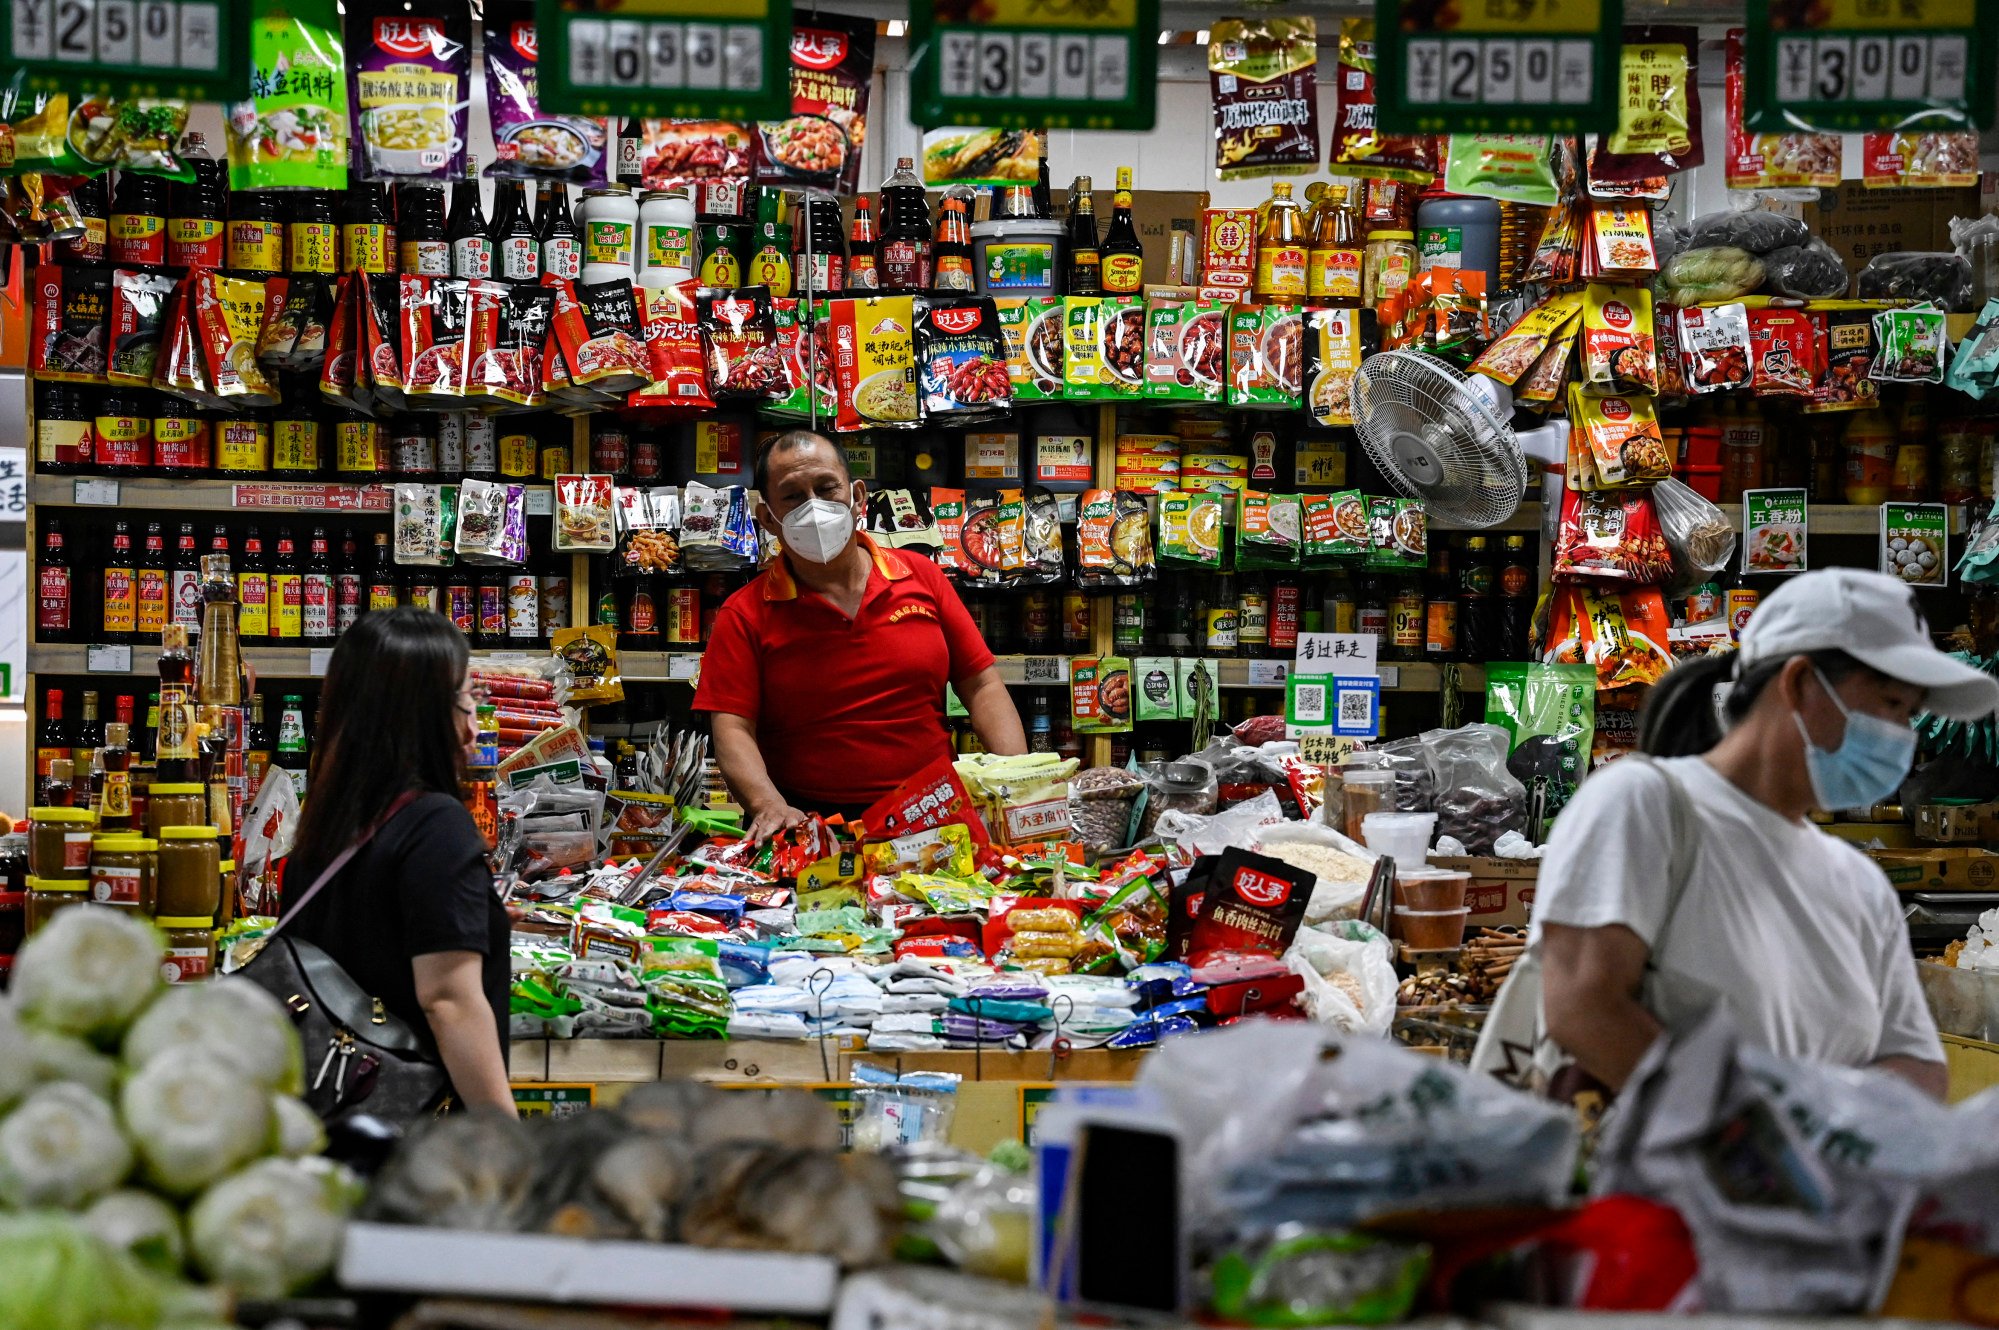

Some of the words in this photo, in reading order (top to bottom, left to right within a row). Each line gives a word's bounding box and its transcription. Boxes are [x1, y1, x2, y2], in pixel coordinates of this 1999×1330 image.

[380, 21, 437, 42] 好人家
[1220, 98, 1309, 130] 万州烤鱼调料
[233, 228, 263, 242] 海天酱油
[1602, 229, 1646, 239] 白胡椒粉
[307, 235, 321, 267] 味极鲜
[885, 249, 914, 260] 海天酱油
[468, 249, 479, 275] 味极鲜
[515, 249, 526, 275] 味极鲜
[557, 249, 569, 275] 味极鲜
[887, 263, 912, 273] 老抽王
[77, 292, 99, 304] 牛油
[591, 300, 632, 313] 小龙虾
[715, 303, 752, 315] 好家
[45, 299, 58, 330] 海底捞
[121, 302, 132, 333] 海底捞
[593, 311, 632, 326] 调味料
[935, 311, 978, 326] 好人家
[1154, 312, 1175, 324] 家樂
[1605, 312, 1630, 322] 红太阳
[1235, 316, 1257, 328] 家樂
[475, 311, 489, 353] 筷手小厨
[1692, 327, 1725, 340] 红烧肉
[837, 325, 853, 367] 欧厨
[864, 339, 913, 354] 酸汤肥牛
[1707, 335, 1741, 346] 调味料
[871, 353, 909, 366] 调味料
[1330, 350, 1351, 359] 肥牛
[226, 429, 256, 443] 海天酱油
[106, 442, 139, 452] 生抽酱油
[157, 442, 188, 453] 生抽酱油
[288, 432, 301, 466] 味极鲜
[345, 434, 358, 468] 味极鲜
[1039, 445, 1071, 453] 水塔陈醋
[938, 506, 959, 517] 家樂
[1168, 502, 1186, 512] 家樂
[1308, 503, 1327, 512] 家樂
[1751, 508, 1802, 525] 五香粉
[423, 495, 436, 558] 葱油拌面调料
[1888, 527, 1944, 538] 包子饺子料
[42, 576, 66, 587] 海天酱油
[106, 579, 129, 589] 海天酱油
[140, 581, 163, 591] 海天酱油
[243, 584, 266, 595] 海天酱油
[42, 599, 66, 609] 老抽王
[1277, 603, 1297, 612] 陈年
[1277, 612, 1297, 622] 花雕
[1299, 637, 1368, 660] 看过再走
[1076, 671, 1094, 680] 家樂
[568, 732, 587, 759] Angel
[902, 782, 955, 824] 蒸肉粉
[1018, 808, 1068, 829] 大圣腐竹
[1236, 871, 1285, 900] 好人家
[1212, 905, 1284, 941] 鱼香肉丝调料
